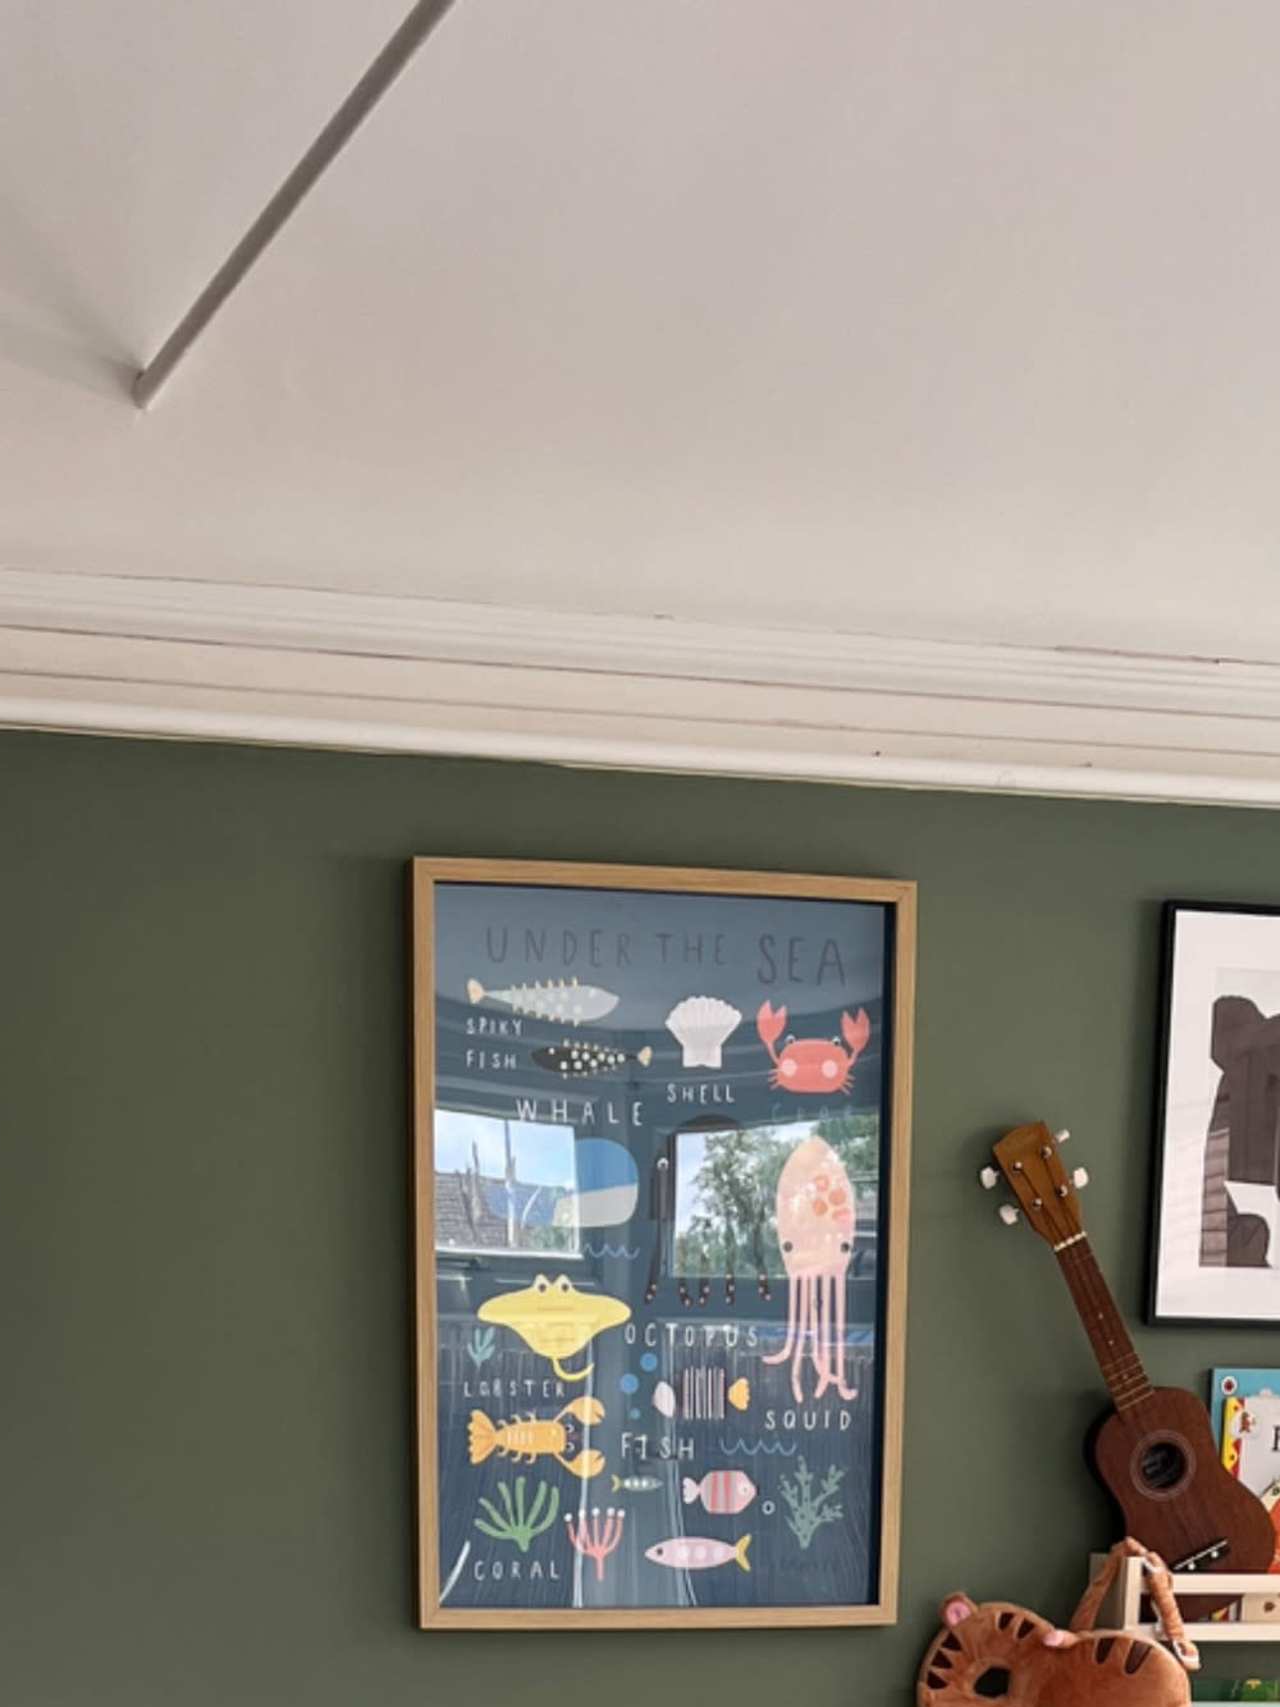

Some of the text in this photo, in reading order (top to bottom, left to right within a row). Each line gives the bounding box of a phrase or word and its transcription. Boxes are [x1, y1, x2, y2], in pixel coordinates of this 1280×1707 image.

[486, 926, 847, 987] UNDER THE SEA
[465, 1017, 523, 1036] SPIKY
[466, 1049, 517, 1070] FISH
[666, 1082, 735, 1104] SHELL
[515, 1096, 644, 1127] WHALE
[625, 1322, 758, 1348] OCTOPUS
[463, 1378, 566, 1398] LOBSTER
[764, 1408, 852, 1431] SQUID
[621, 1431, 695, 1460] FISH
[473, 1559, 560, 1582] CORAL
